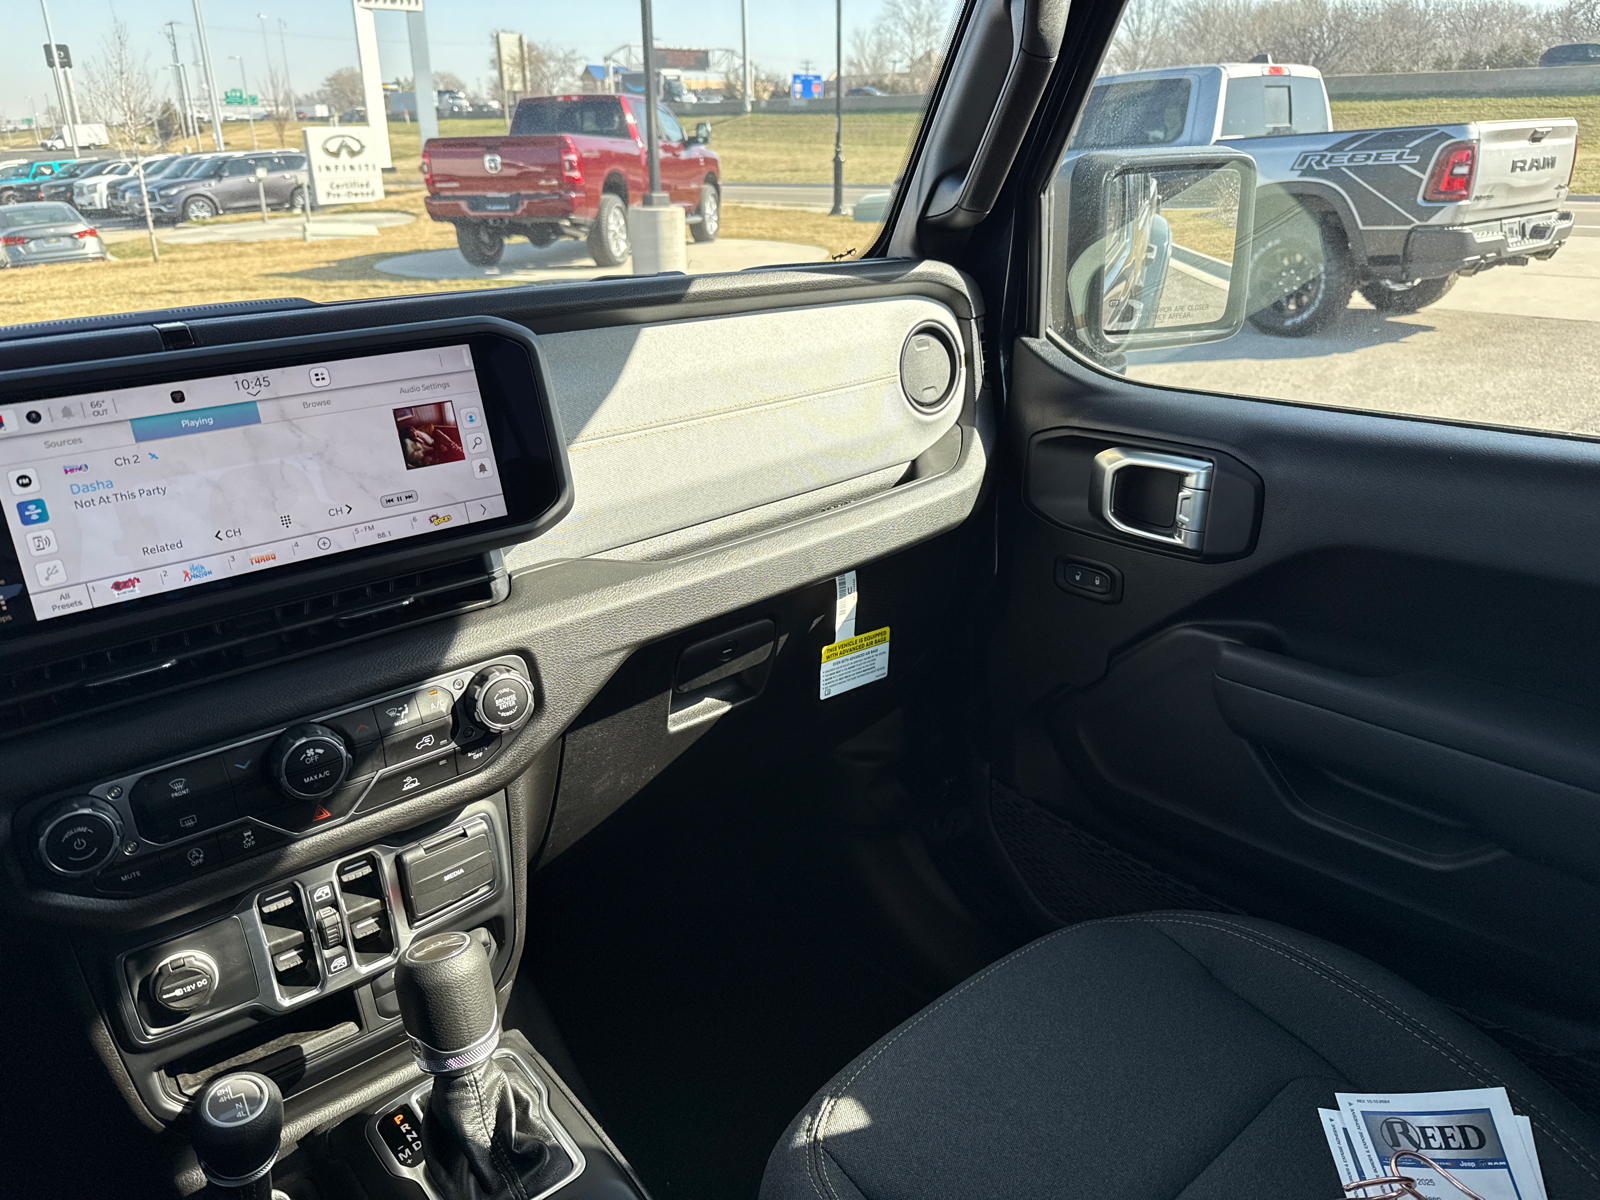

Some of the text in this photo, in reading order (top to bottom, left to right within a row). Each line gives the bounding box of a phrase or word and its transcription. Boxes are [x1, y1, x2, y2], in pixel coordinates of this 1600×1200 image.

[1290, 149, 1420, 172] REBEL
[1510, 156, 1557, 173] RAM
[318, 163, 377, 173] INFINITI
[234, 376, 271, 391] 10:45
[400, 382, 450, 394] Audio Settings
[302, 399, 331, 409] Browse
[92, 408, 108, 417] OUT
[181, 417, 214, 428] Playing
[43, 437, 83, 449] Sources
[114, 454, 141, 467] Ch 2
[69, 479, 114, 495] Dasha
[74, 486, 167, 510] Not At This Party
[328, 506, 344, 517] CH
[225, 527, 242, 539] CH
[142, 539, 184, 556] Related
[60, 592, 71, 601] All
[52, 600, 83, 612] Presets
[826, 652, 839, 660] WITH
[839, 643, 866, 656] ADVANCED
[874, 636, 887, 645] BAGS
[827, 646, 838, 654] THIS
[838, 639, 858, 650] VEHICLE
[864, 630, 887, 642] EQUIPPED
[430, 699, 446, 710] A/C
[500, 700, 516, 710] ENTER
[394, 718, 409, 727] MODE
[305, 754, 320, 765] OFF
[472, 752, 483, 760] OFF
[303, 770, 331, 784] MAX A/C
[171, 788, 190, 798] FRONT
[63, 826, 88, 840] VOLUME
[243, 840, 256, 849] OFF
[120, 870, 141, 881] MUTE
[443, 868, 465, 881] MEDIA
[183, 978, 208, 993] 12V DC
[216, 1086, 229, 1096] 2H
[218, 1094, 231, 1103] 4H
[235, 1101, 243, 1110] N
[236, 1110, 247, 1118] 4L
[394, 1114, 404, 1125] P
[1349, 1107, 1362, 1131] ADHESIVE
[400, 1123, 412, 1133] R
[406, 1130, 418, 1142] N
[1359, 1129, 1370, 1150] EXPOSE
[1381, 1117, 1486, 1152] REED
[411, 1140, 422, 1152] D
[397, 1148, 412, 1161] M
[1368, 1154, 1379, 1174] BORDER
[1459, 1160, 1476, 1168] Jeep
[1416, 1178, 1435, 1187] 2025
